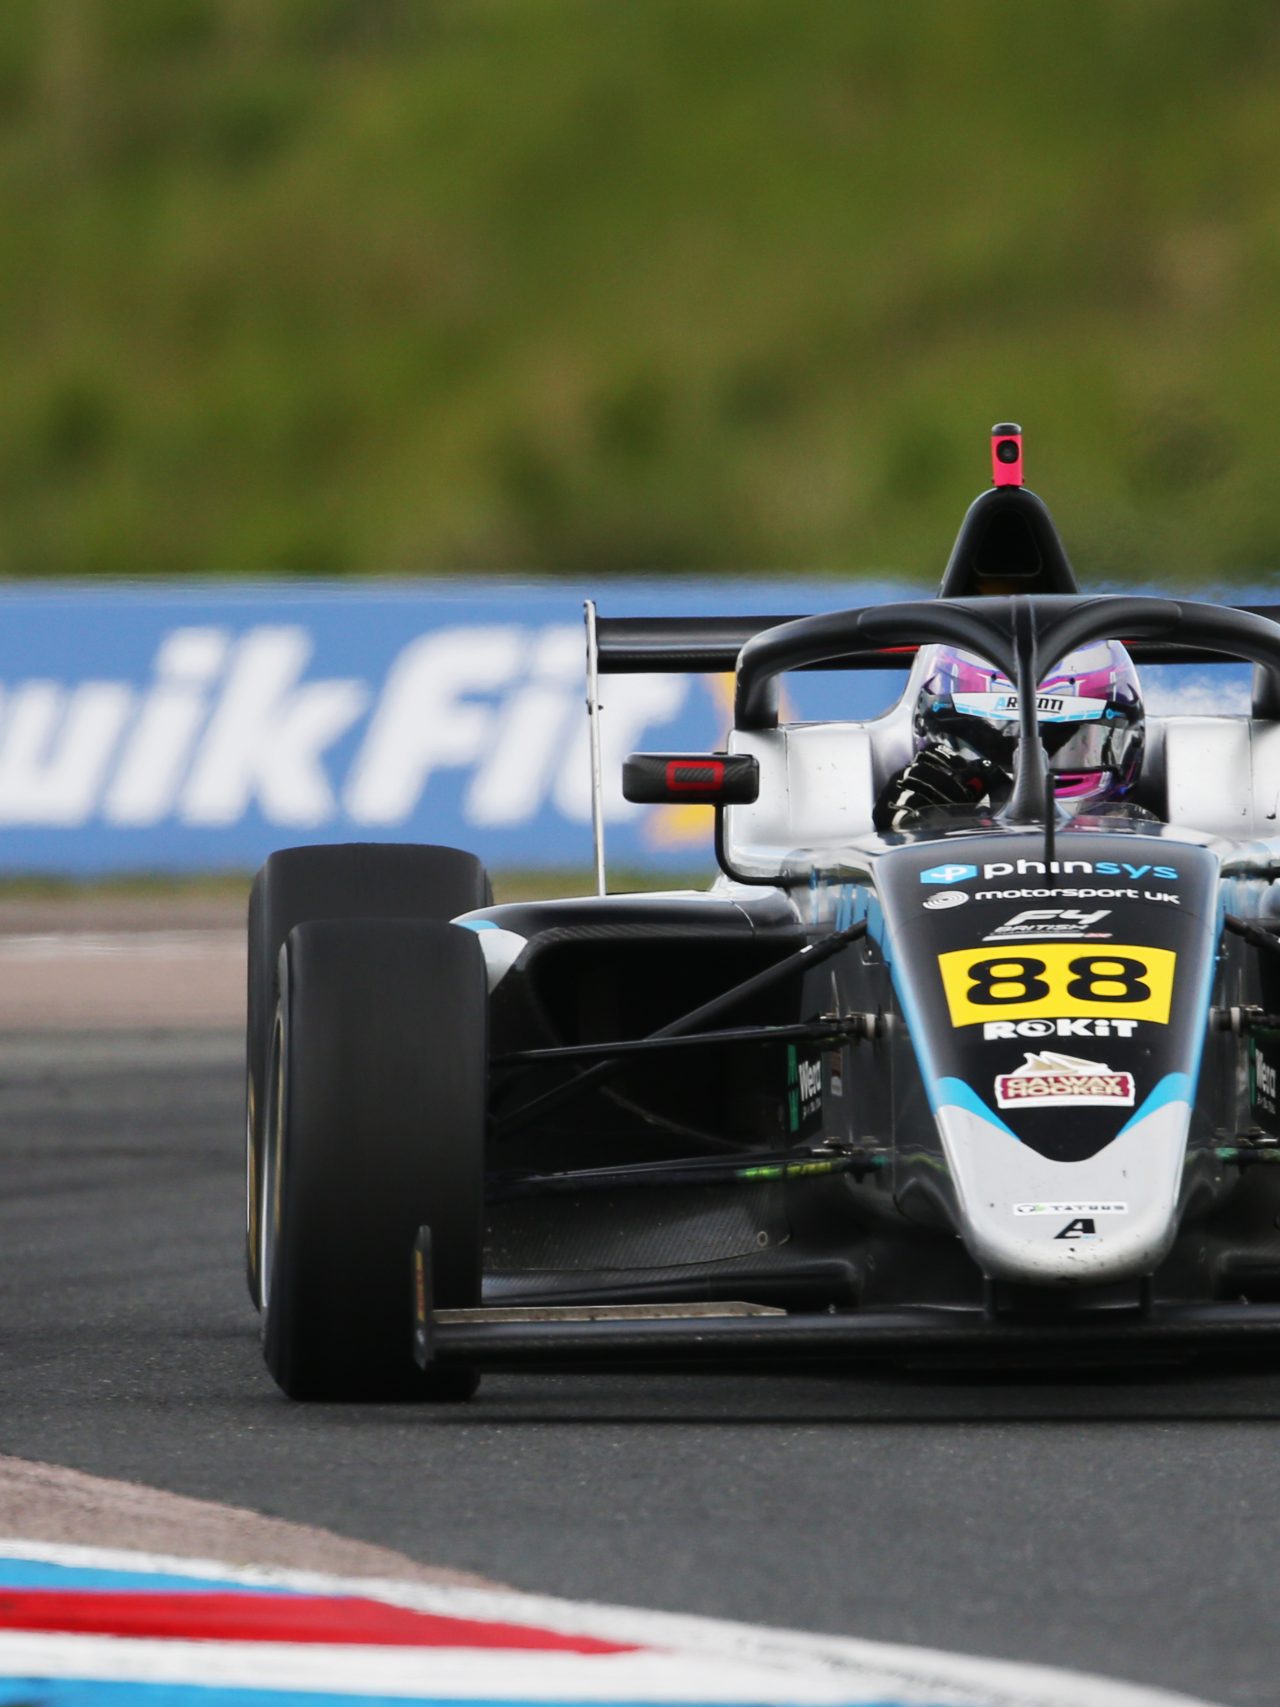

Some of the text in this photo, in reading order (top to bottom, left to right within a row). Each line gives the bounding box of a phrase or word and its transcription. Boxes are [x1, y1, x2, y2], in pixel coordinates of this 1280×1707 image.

[983, 859, 1179, 880] phinsys
[975, 888, 1139, 900] motorsport
[1003, 909, 1113, 926] F4
[966, 956, 1152, 1006] 88
[1007, 1076, 1122, 1088] GALWAY
[1007, 1085, 1124, 1098] HOOKER
